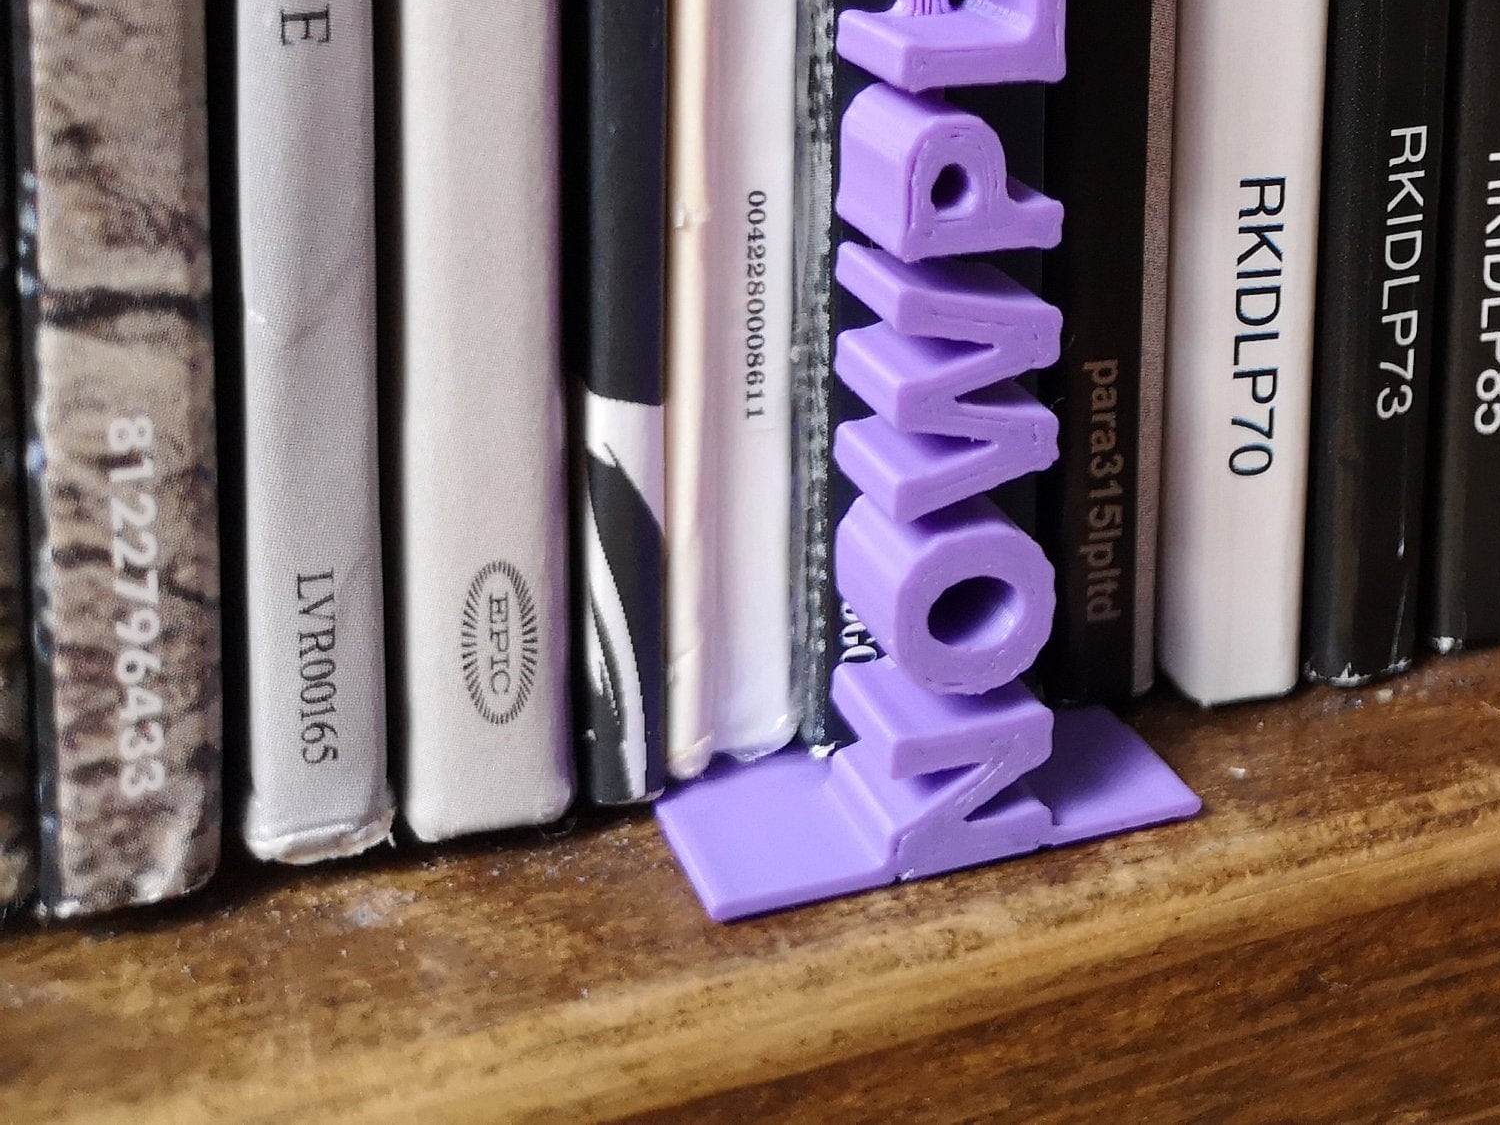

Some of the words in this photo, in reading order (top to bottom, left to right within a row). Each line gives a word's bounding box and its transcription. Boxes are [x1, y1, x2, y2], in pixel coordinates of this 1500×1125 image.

[744, 189, 768, 421] 0042280008611
[1227, 175, 1287, 478] RKIDLP70
[1375, 125, 1428, 421] RKIDLP73
[107, 410, 166, 801] 8122796433
[295, 568, 340, 767] LVR00165
[487, 592, 511, 695] EPIC
